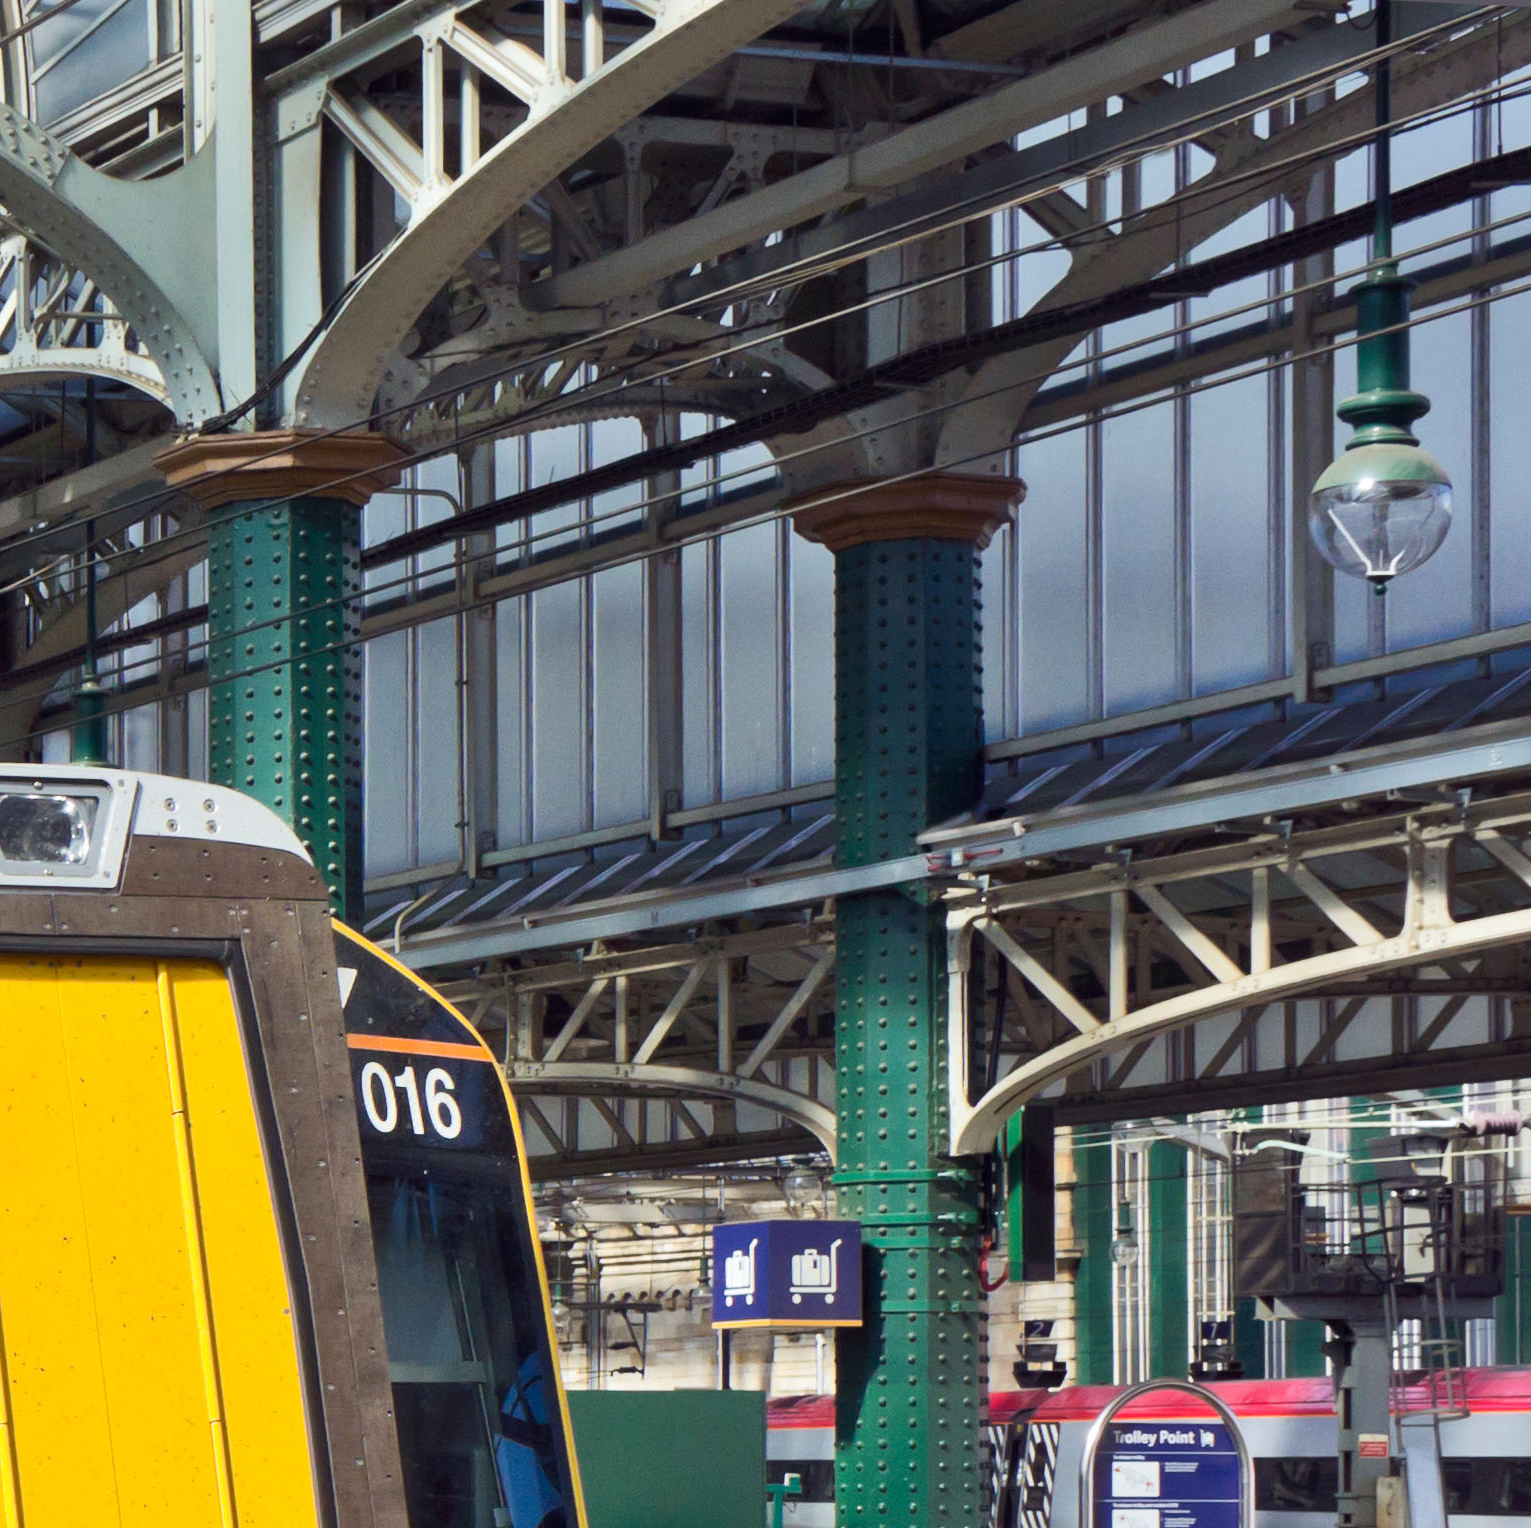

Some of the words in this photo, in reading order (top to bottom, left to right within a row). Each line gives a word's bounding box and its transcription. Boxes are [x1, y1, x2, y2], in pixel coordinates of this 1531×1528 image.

[361, 1061, 462, 1139] 016
[1029, 1321, 1044, 1337] 2
[1209, 1323, 1218, 1338] 1
[1114, 1430, 1157, 1447] Trolley
[1159, 1430, 1195, 1444] Point
